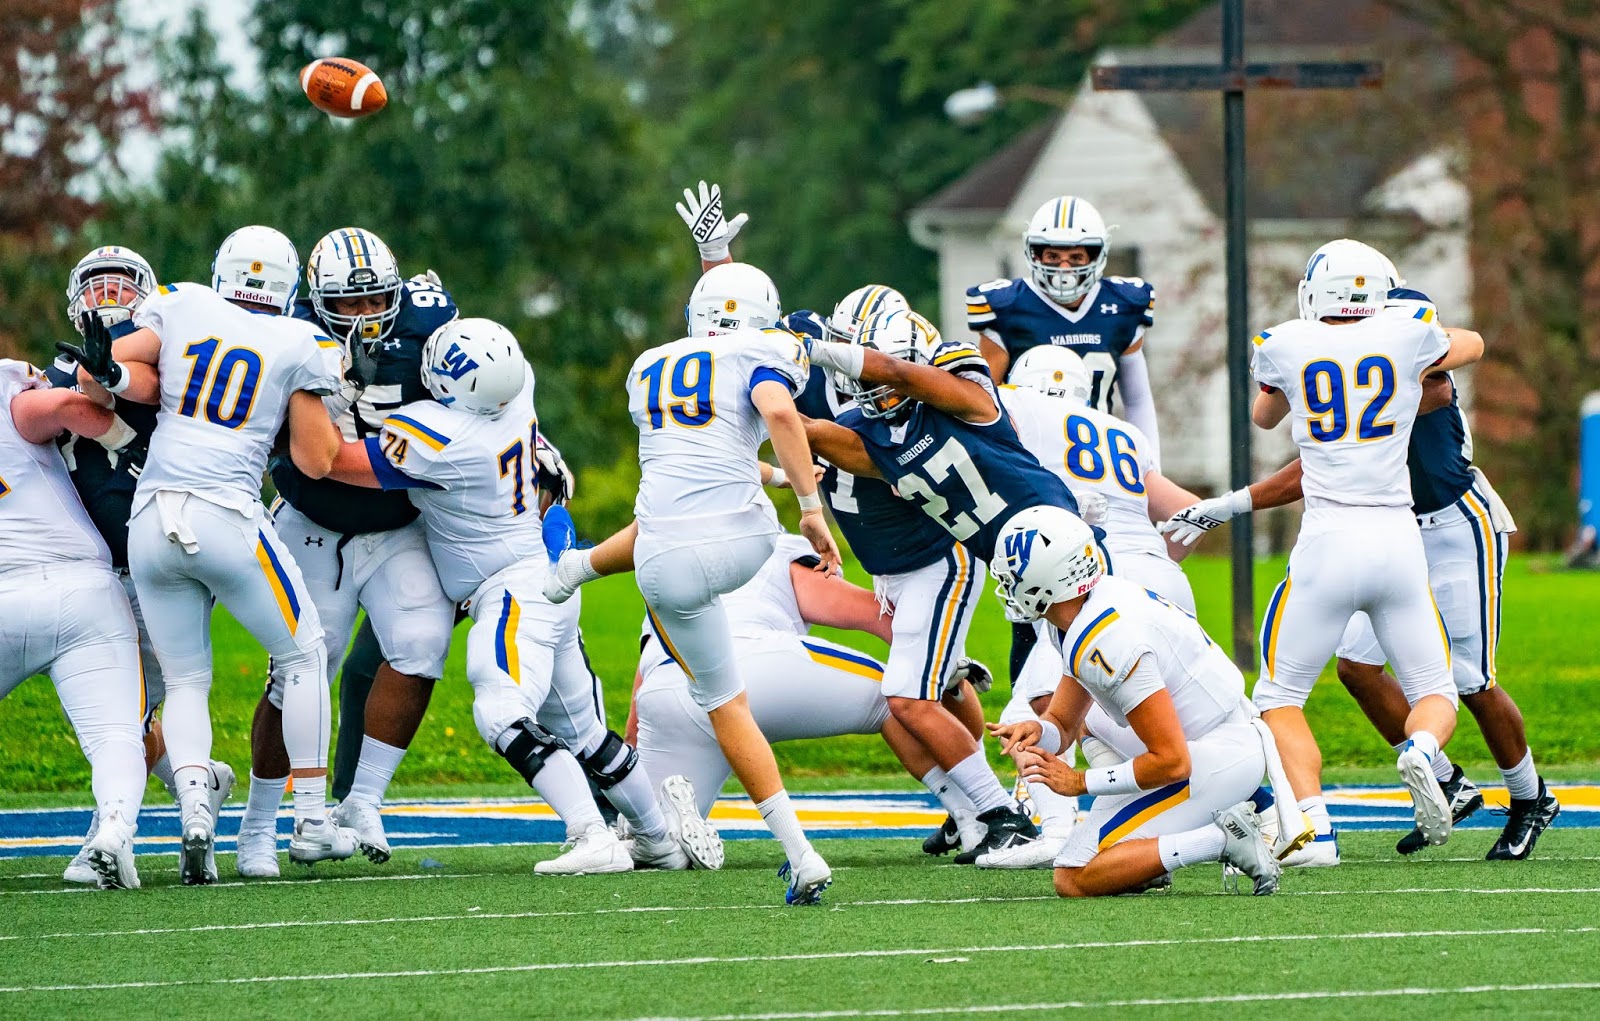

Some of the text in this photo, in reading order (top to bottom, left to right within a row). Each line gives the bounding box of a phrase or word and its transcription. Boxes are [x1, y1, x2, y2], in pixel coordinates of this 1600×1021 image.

[234, 290, 273, 303] Riddell
[1341, 307, 1376, 315] Riddell
[1050, 334, 1101, 345] WARRIORS
[180, 335, 264, 431] 10
[637, 350, 716, 431] 19
[1301, 353, 1398, 443] 92
[383, 431, 409, 465] 74
[1063, 413, 1147, 497] 86
[897, 436, 1008, 541] 27
[1088, 648, 1115, 677] 7
[1224, 821, 1248, 840] NIKE
